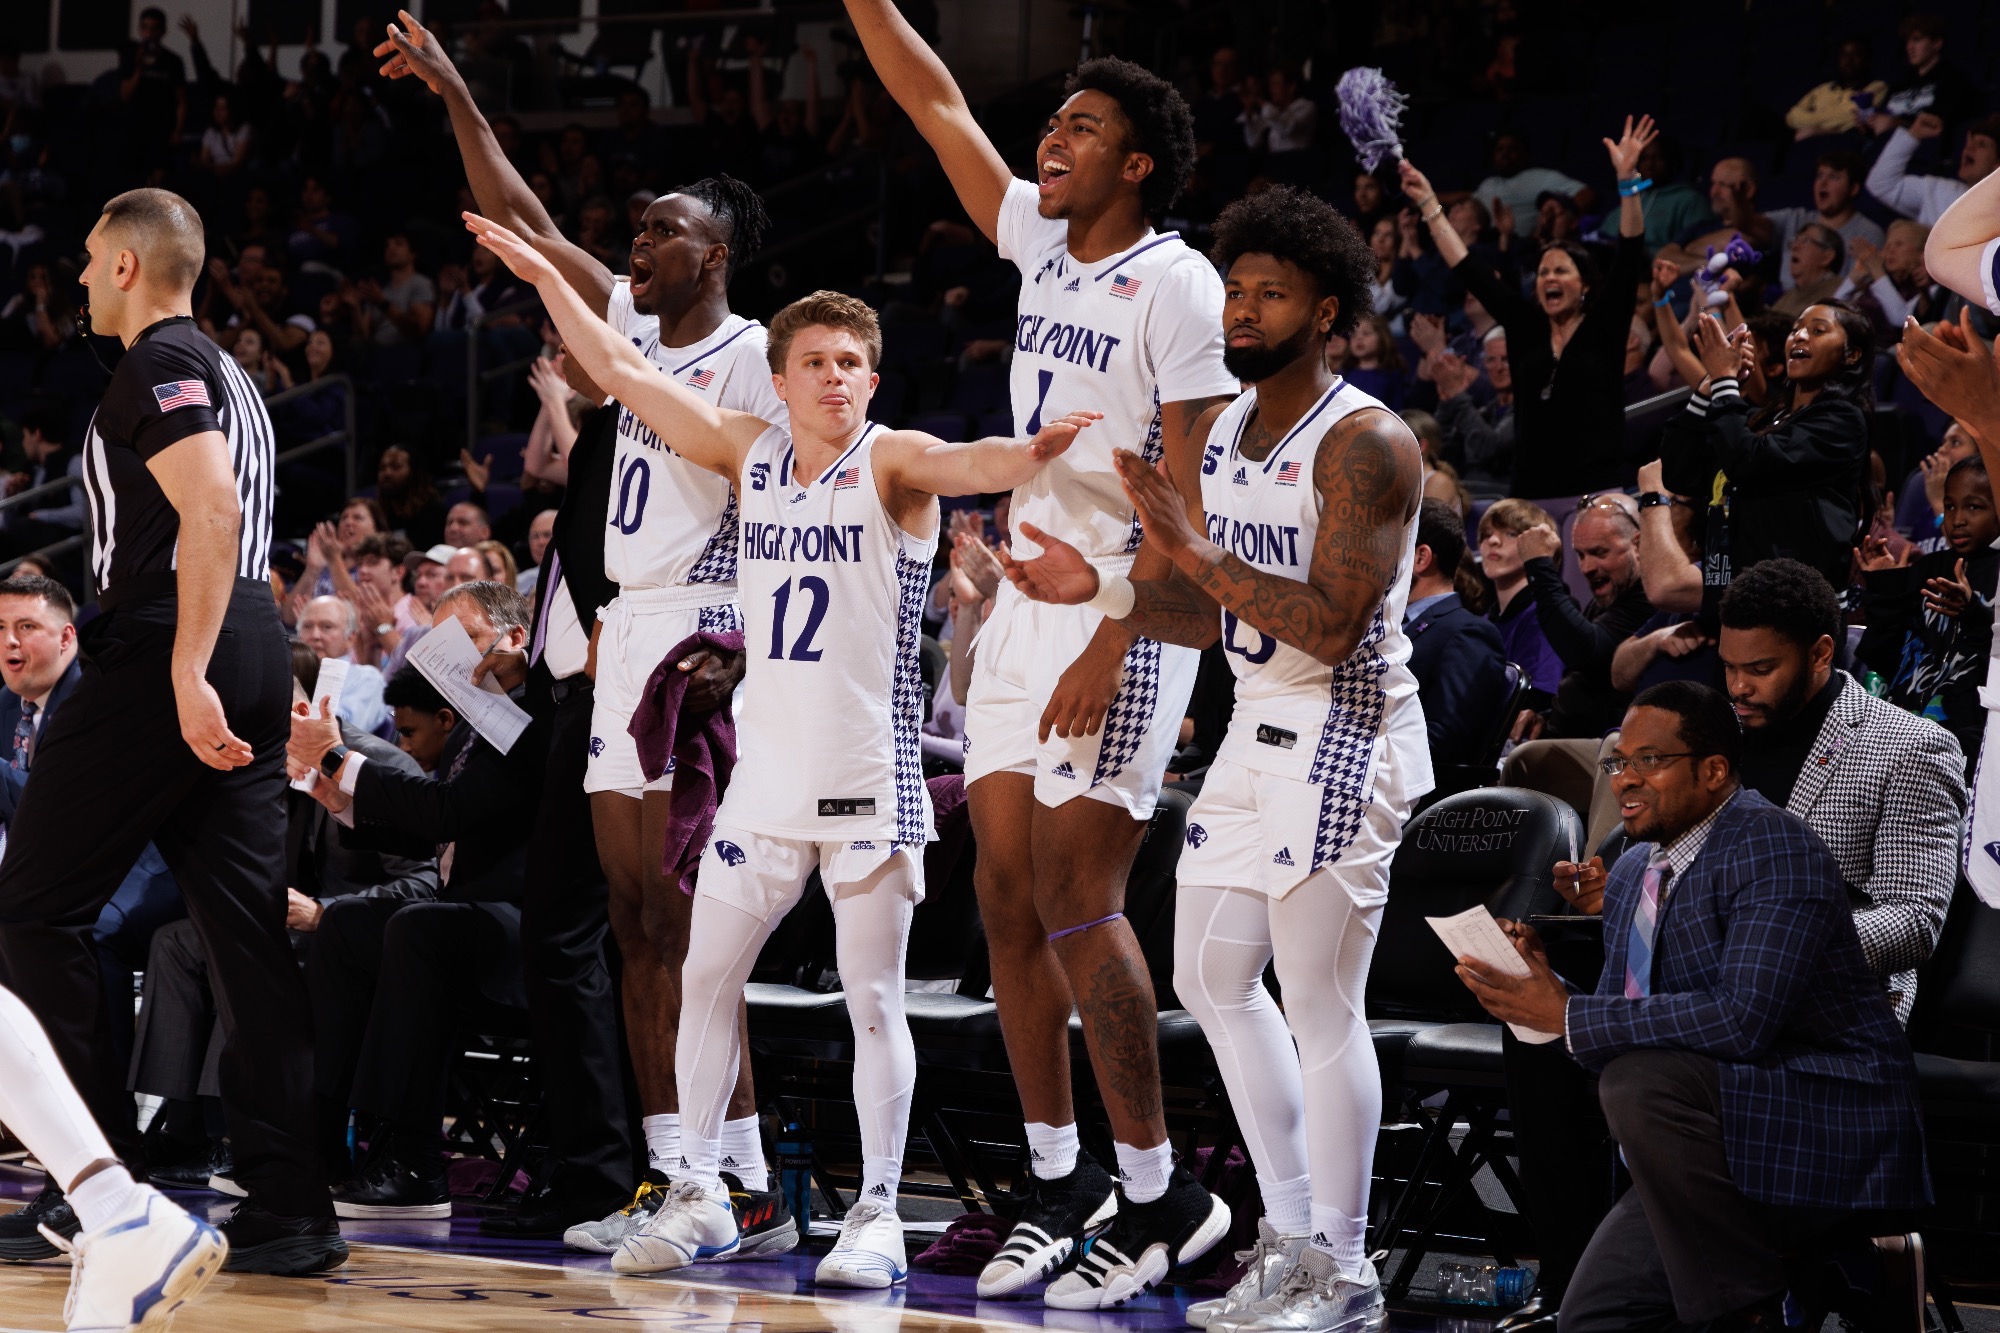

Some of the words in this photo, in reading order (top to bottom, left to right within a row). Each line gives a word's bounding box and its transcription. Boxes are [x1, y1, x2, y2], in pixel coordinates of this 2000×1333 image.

[1038, 323, 1121, 373] POINT
[609, 452, 650, 535] 10
[744, 521, 786, 562] HIGH
[789, 524, 864, 563] POINT
[1231, 520, 1299, 566] POINT
[767, 574, 831, 663] 12
[1051, 768, 1076, 780] adidas
[1420, 807, 1470, 828] HIGH
[1469, 807, 1530, 829] POINT
[850, 843, 876, 851] adidas
[1416, 828, 1518, 853] UNIVERSITY
[1272, 856, 1295, 867] adidas
